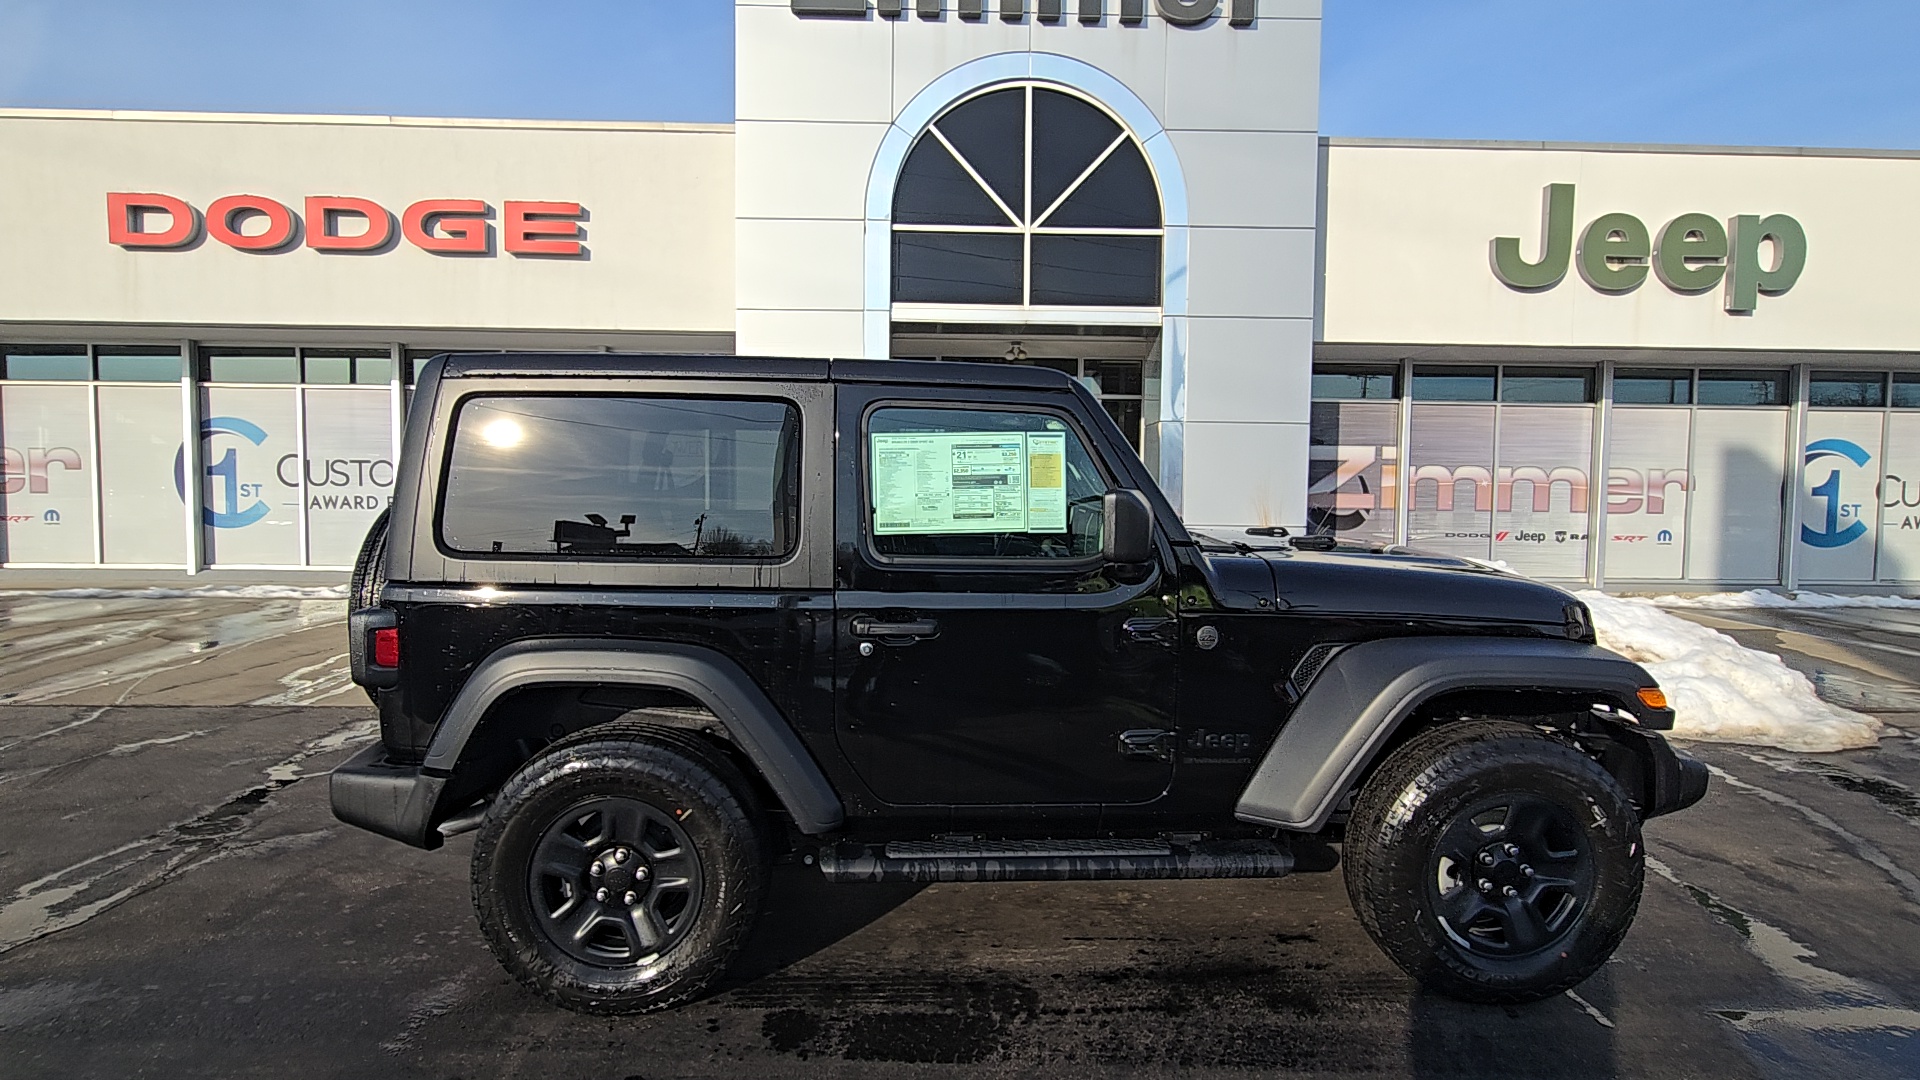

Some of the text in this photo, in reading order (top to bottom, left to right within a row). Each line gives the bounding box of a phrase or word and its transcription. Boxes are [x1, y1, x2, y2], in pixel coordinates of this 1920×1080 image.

[106, 191, 590, 258] DODGE
[1488, 183, 1807, 317] Jeep
[956, 451, 967, 460] 21
[1308, 444, 1696, 515] Zimmer
[309, 495, 379, 510] AWARD
[1514, 530, 1547, 544] Jeep
[1611, 535, 1648, 543] SRT
[1186, 728, 1251, 753] Jeep
